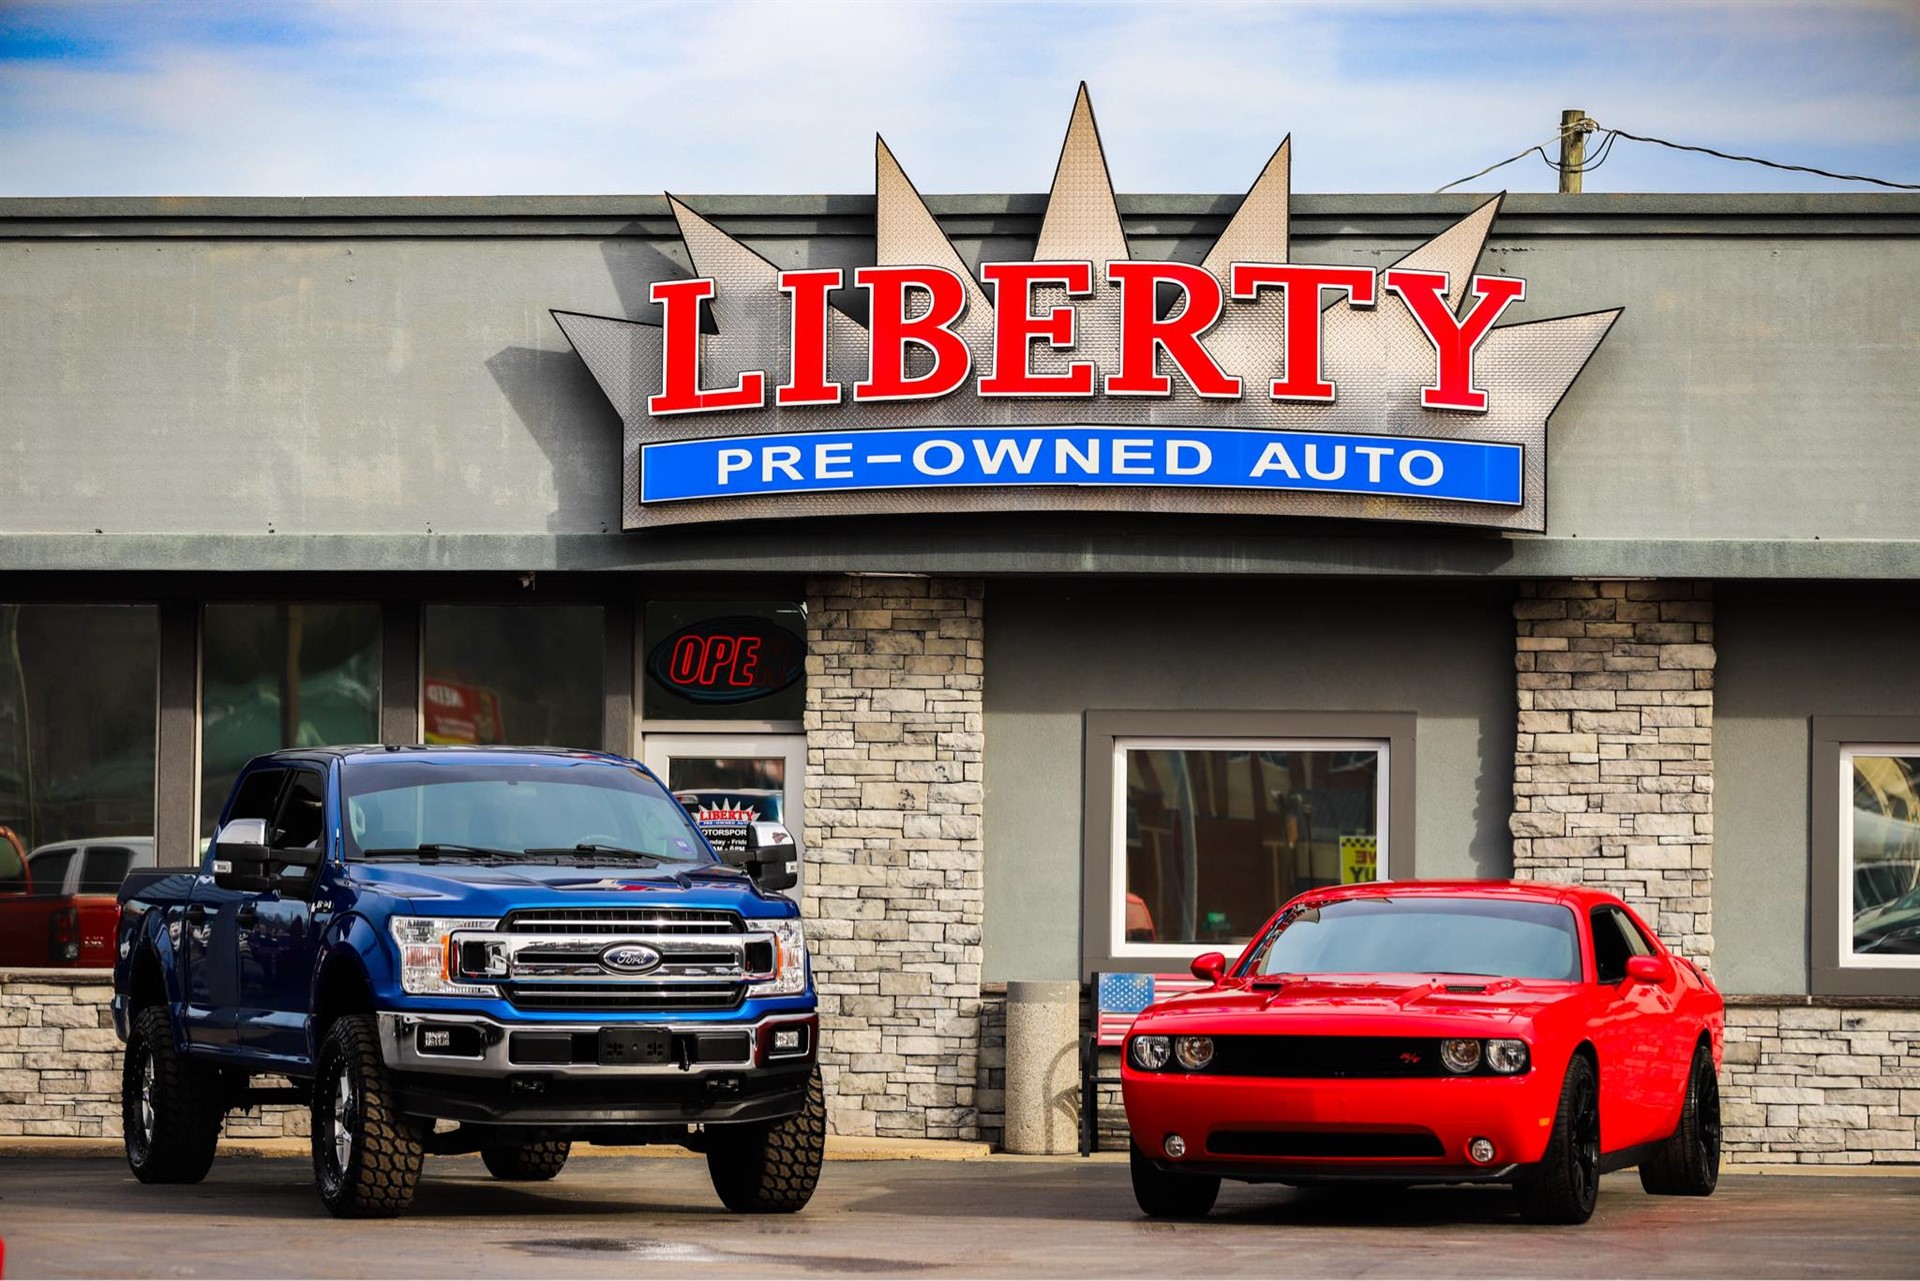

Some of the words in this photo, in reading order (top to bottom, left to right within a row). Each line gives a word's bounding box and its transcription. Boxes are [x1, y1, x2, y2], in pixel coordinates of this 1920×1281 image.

[648, 261, 1526, 415] LIBERTY
[717, 438, 1213, 485] PRE-OWNED
[1250, 442, 1444, 487] AUTO
[669, 634, 763, 686] OPE
[700, 810, 754, 821] LIBERTY
[617, 951, 647, 965] Ford
